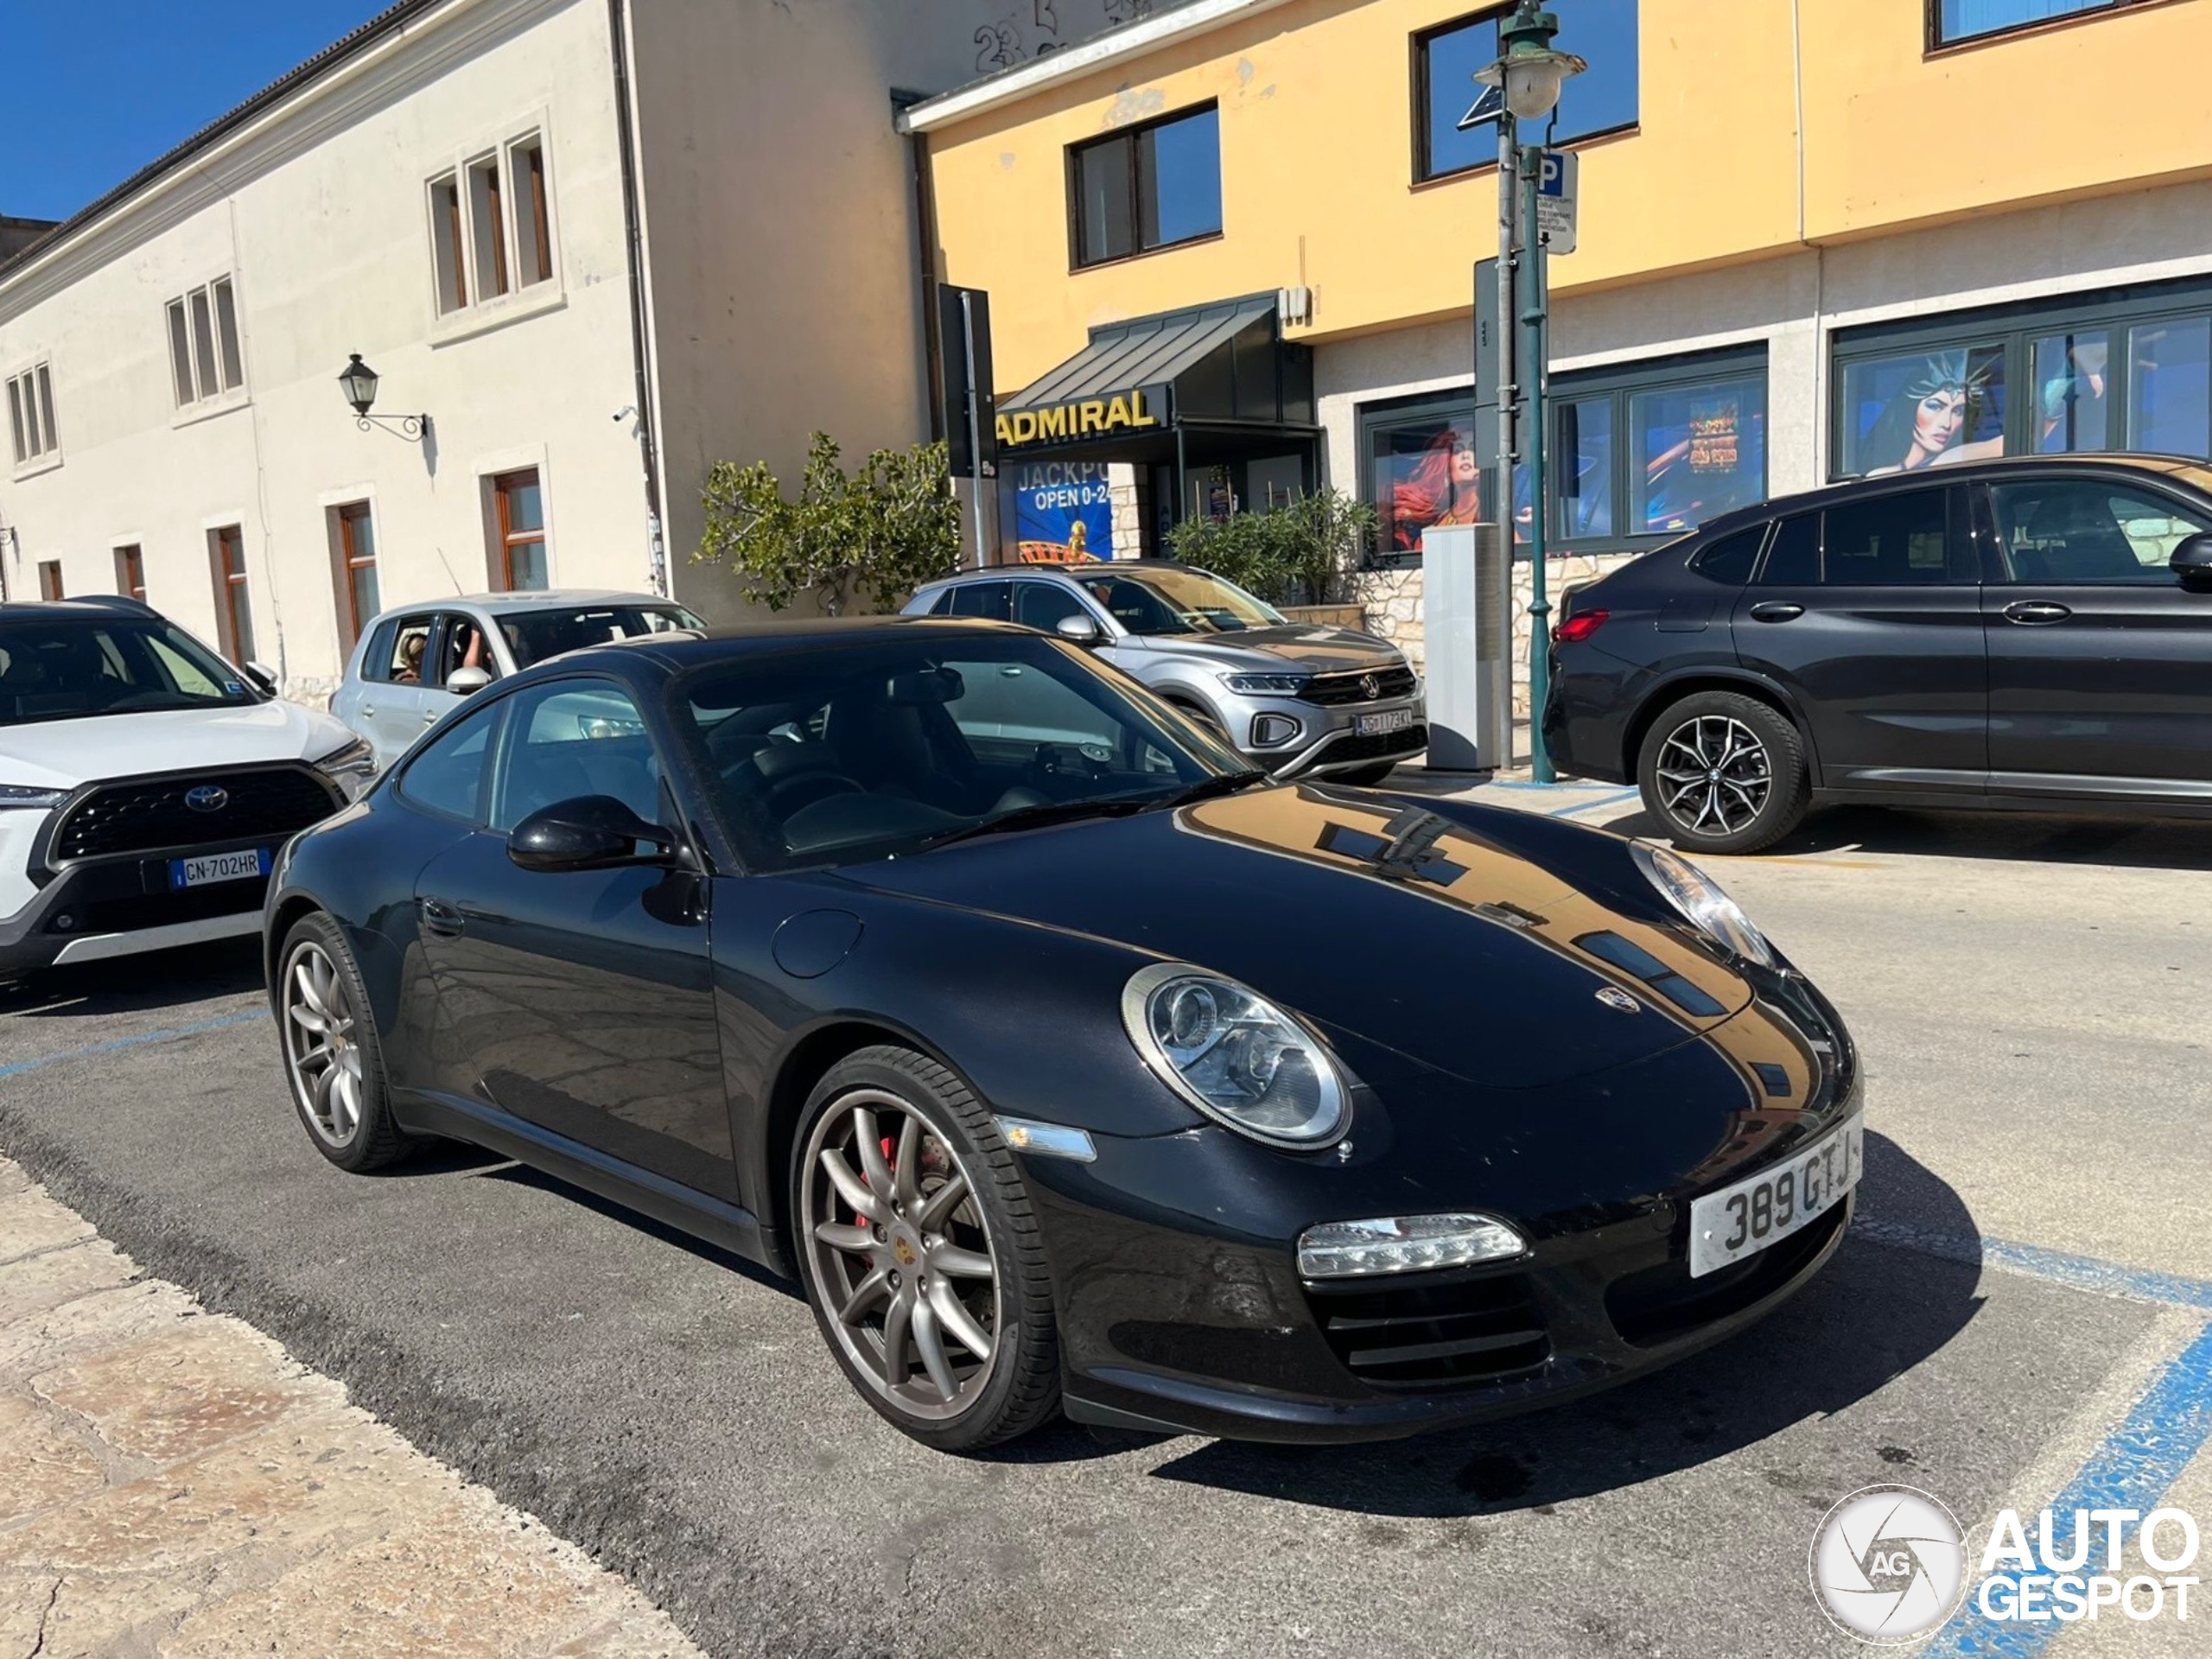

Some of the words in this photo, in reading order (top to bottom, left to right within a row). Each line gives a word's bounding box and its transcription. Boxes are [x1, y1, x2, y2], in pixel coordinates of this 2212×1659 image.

[1539, 159, 1558, 191] P
[995, 390, 1154, 447] ADMIRAL
[1035, 488, 1078, 510] OPEN
[1725, 1171, 1795, 1250] 389
[1803, 1130, 1850, 1212] GTJ
